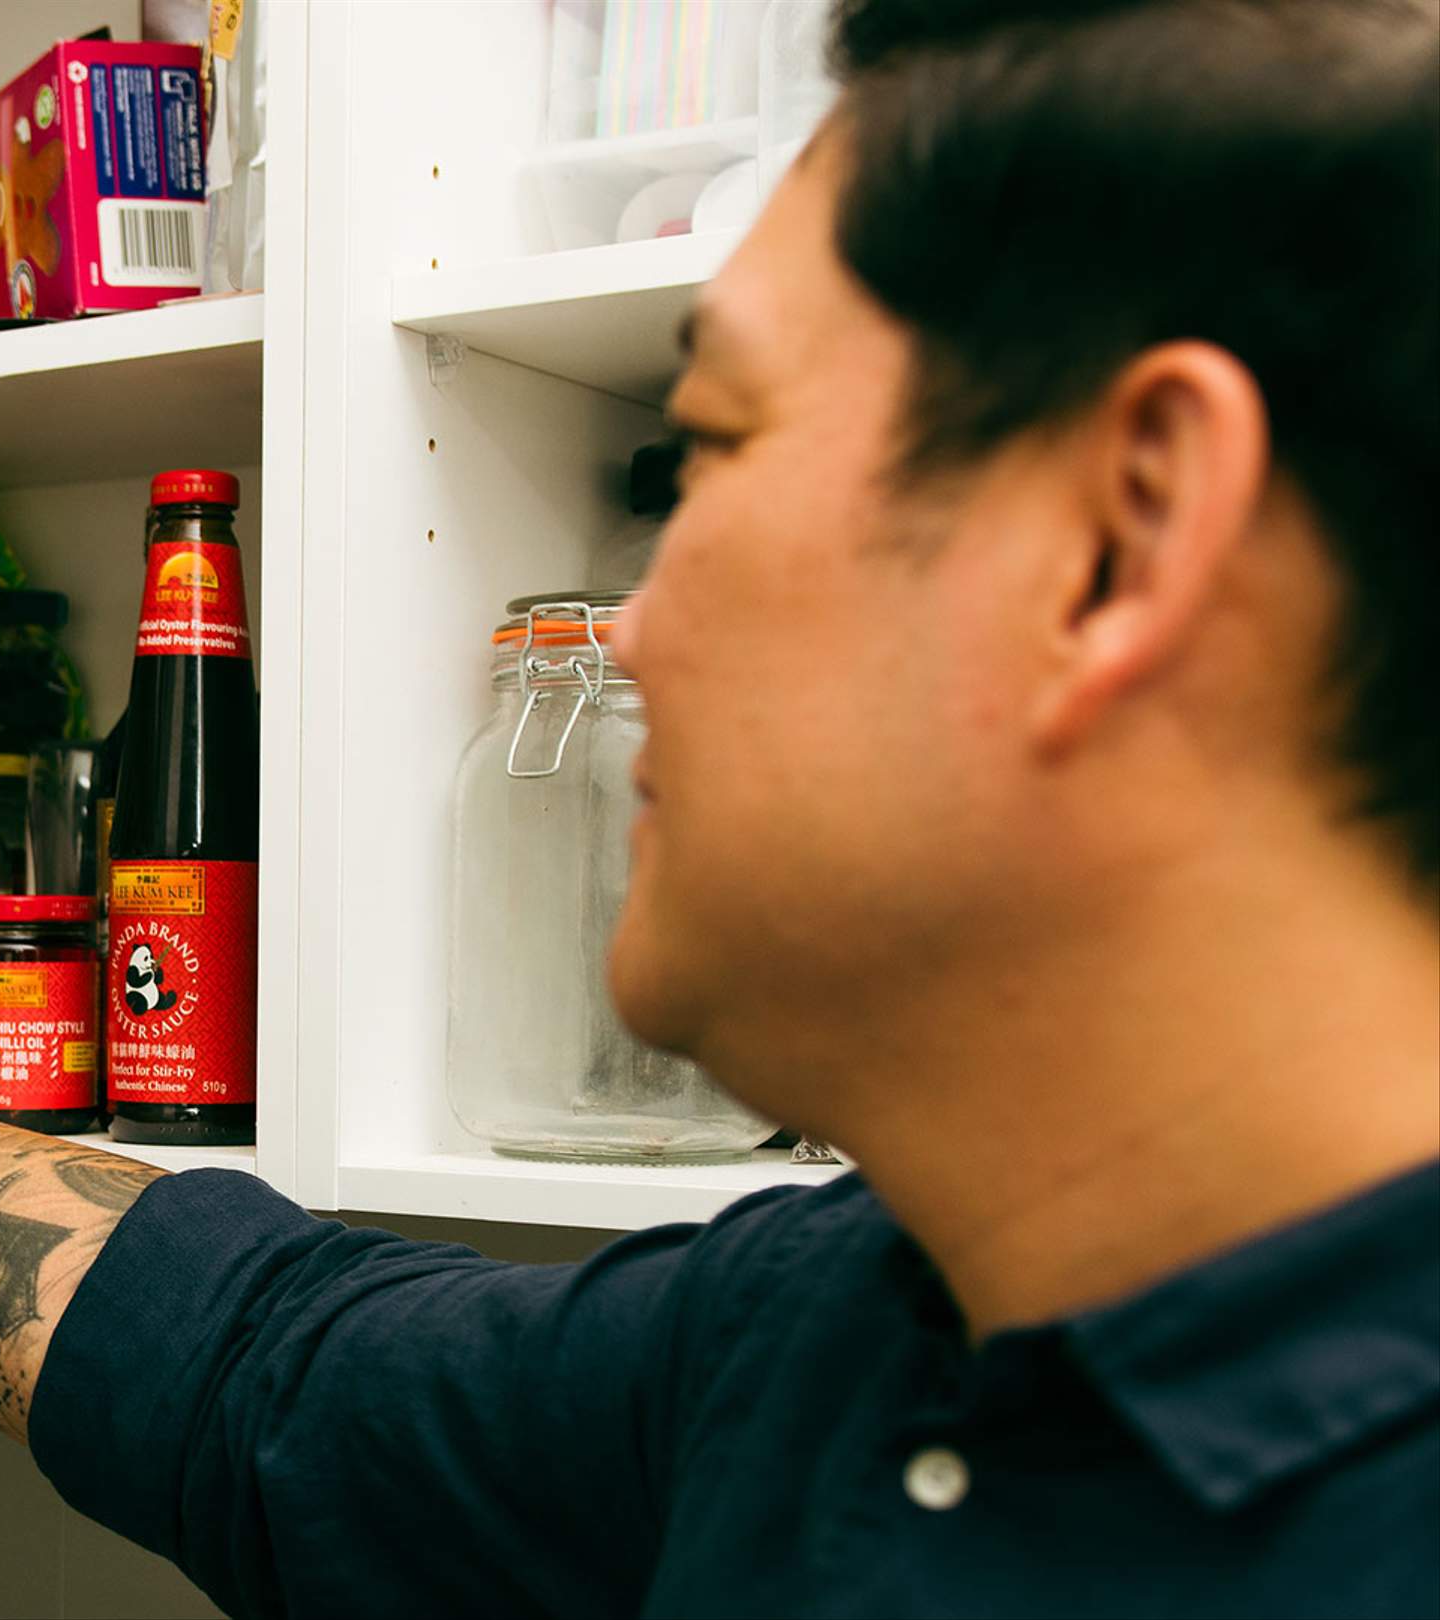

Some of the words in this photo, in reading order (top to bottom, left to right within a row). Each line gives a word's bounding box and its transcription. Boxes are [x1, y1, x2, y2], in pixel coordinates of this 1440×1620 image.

[160, 619, 190, 633] Oyster
[192, 619, 238, 638] Flavouring
[147, 634, 172, 646] Added
[173, 634, 237, 651] Preservatives
[132, 885, 162, 898] KUM
[168, 885, 194, 899] KEE
[112, 921, 146, 970] PANDA
[148, 921, 200, 973] BRAND
[111, 987, 148, 1040] OYSTER
[150, 990, 200, 1038] SAUCE
[18, 1021, 56, 1035] CHOW
[26, 1036, 47, 1050] OIL
[135, 1063, 151, 1078] for
[152, 1063, 196, 1080] Stir-Fry
[147, 1080, 189, 1094] Chinese
[202, 1081, 228, 1096] 510g
